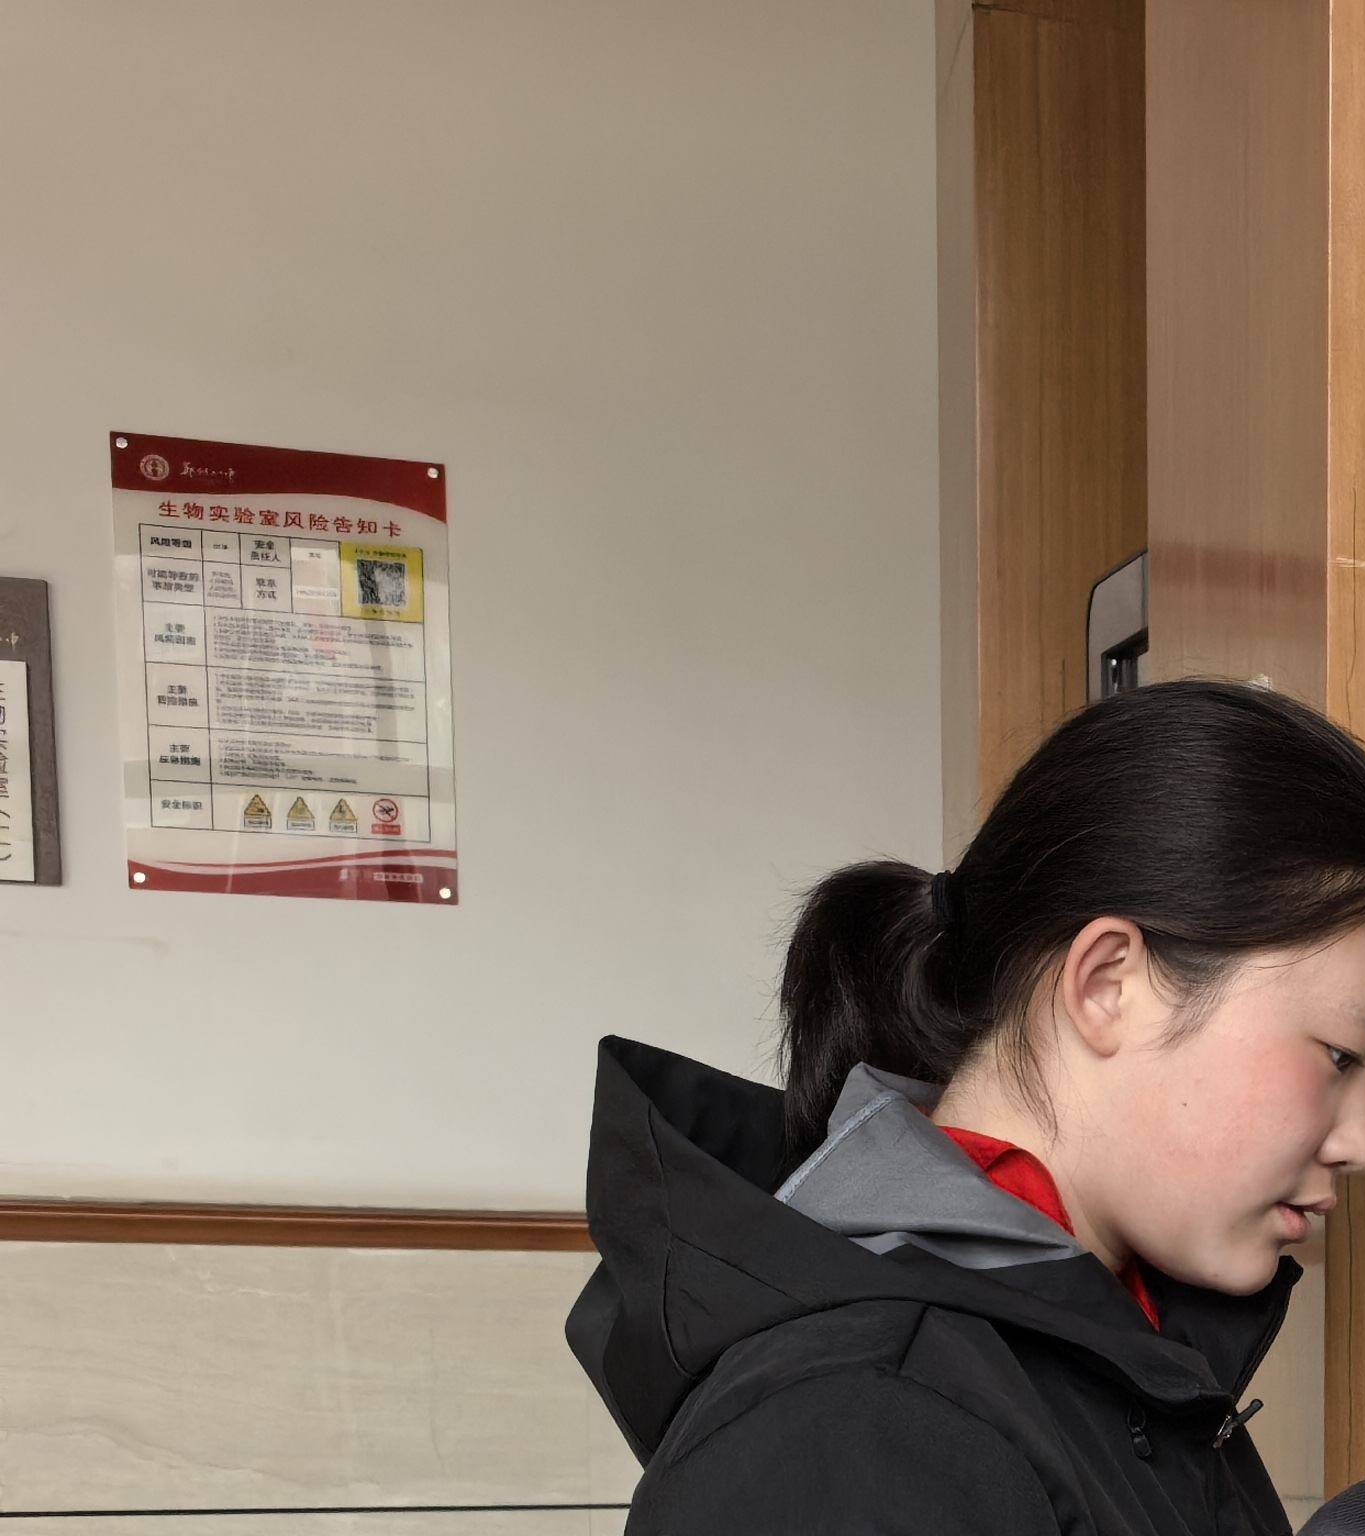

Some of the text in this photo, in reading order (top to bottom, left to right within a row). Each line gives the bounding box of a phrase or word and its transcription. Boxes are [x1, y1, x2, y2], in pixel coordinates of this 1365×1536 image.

[157, 500, 403, 539] 生物实验室风险告知卡
